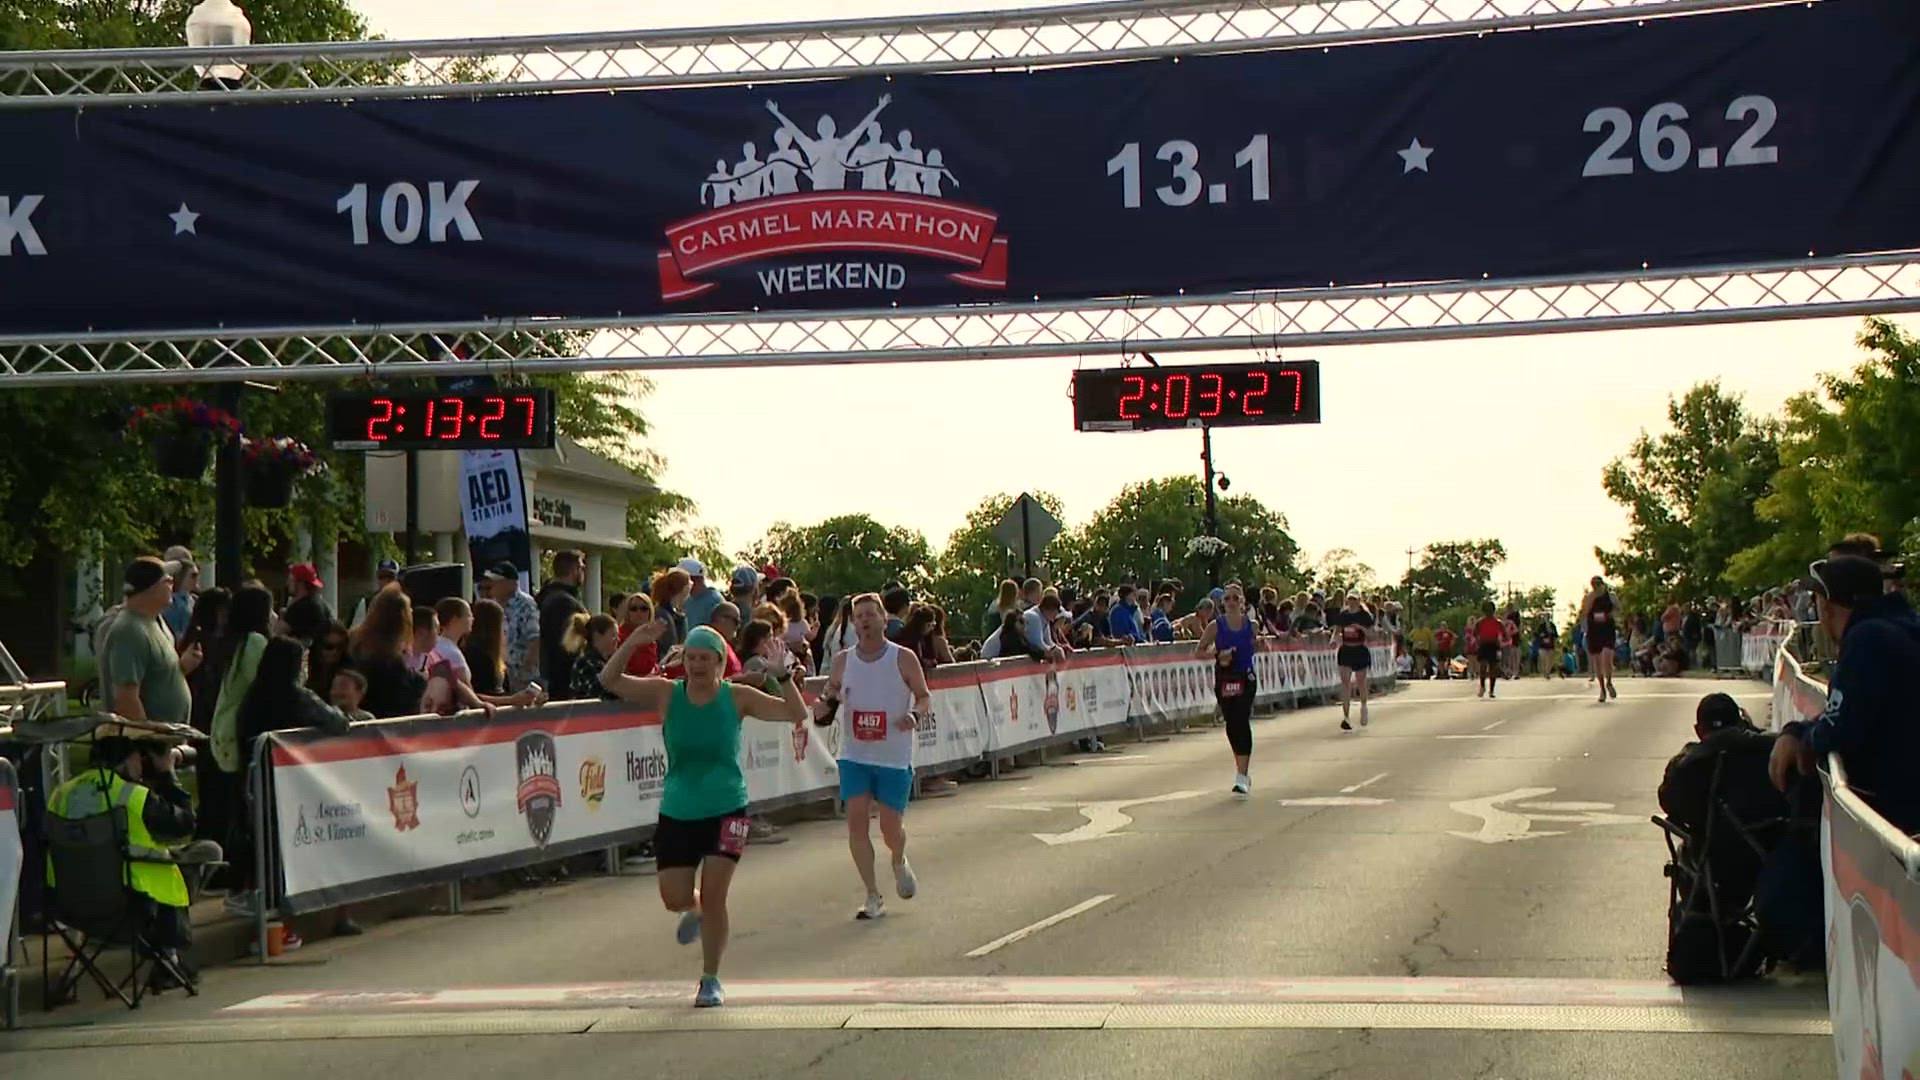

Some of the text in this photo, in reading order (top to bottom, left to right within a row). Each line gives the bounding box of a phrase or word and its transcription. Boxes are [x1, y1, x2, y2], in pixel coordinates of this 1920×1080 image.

[1581, 95, 1778, 178] 26.2
[1105, 133, 1271, 209] 13.1
[336, 179, 484, 246] 10K
[678, 208, 981, 256] CARMEL MARATHON
[756, 263, 908, 297] WEEKEND
[467, 467, 512, 510] AED
[471, 502, 513, 522] STATION
